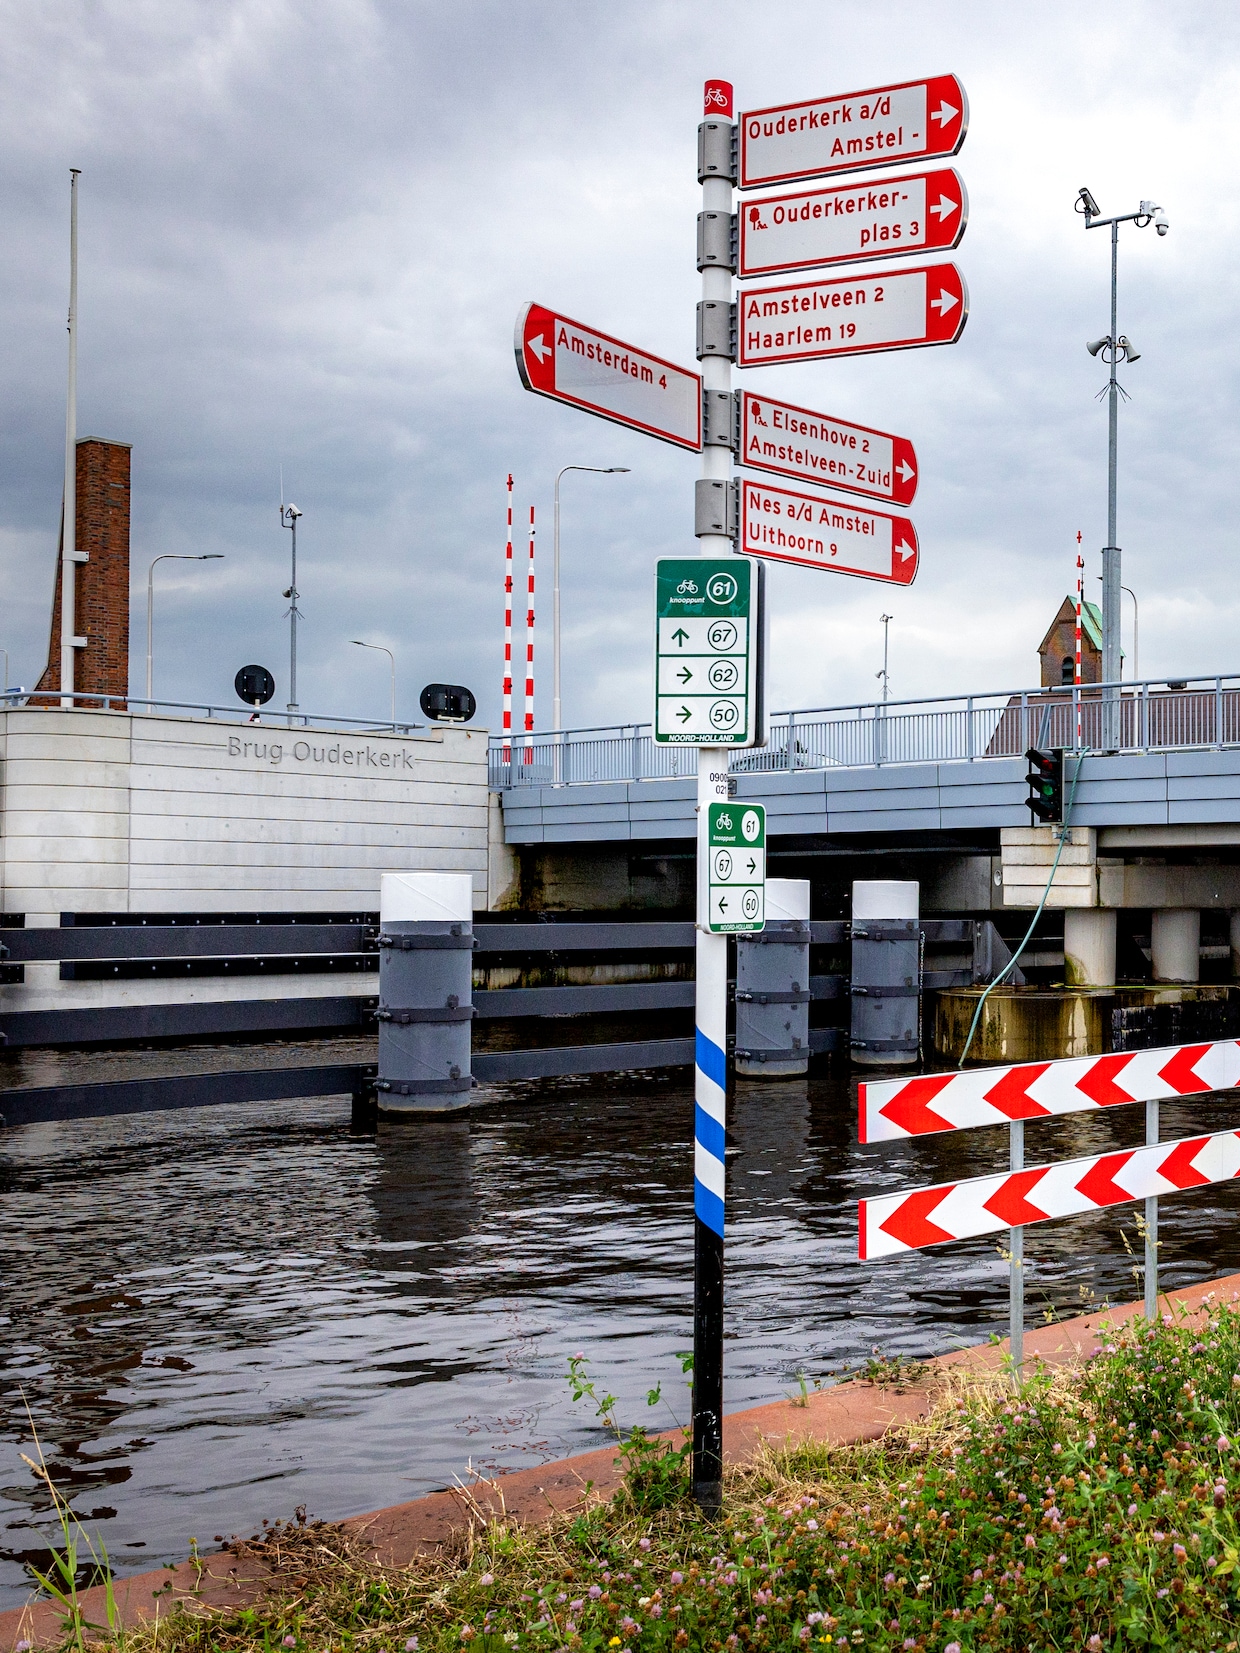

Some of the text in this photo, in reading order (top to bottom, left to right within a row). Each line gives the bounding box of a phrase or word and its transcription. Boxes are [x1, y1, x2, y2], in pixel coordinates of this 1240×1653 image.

[748, 96, 891, 140] Ouderkerk a/d
[830, 127, 903, 157] Amstel
[773, 191, 909, 225] Ouderkerker-
[860, 221, 920, 248] plas 3
[747, 286, 885, 318] Amstelveen 2
[748, 322, 857, 350] Haarlem 19
[557, 327, 667, 390] Amsterdam 4
[773, 409, 870, 453] Elsenhove 2
[750, 435, 890, 488] Amstelveen-Zuid
[750, 491, 875, 536] Nes a/d Amstel
[749, 522, 838, 557] Uithoorn 9
[669, 596, 706, 605] knooppunt
[712, 581, 731, 596] 61
[711, 628, 732, 643] 67
[712, 668, 733, 683] 62
[713, 708, 735, 723] 50
[668, 734, 735, 742] NOORD-HOLLAND
[228, 736, 414, 769] Brug Ouderkerk
[713, 834, 736, 842] knooppunt
[746, 820, 756, 833] 61
[719, 859, 730, 873] 67
[746, 898, 756, 911] 60
